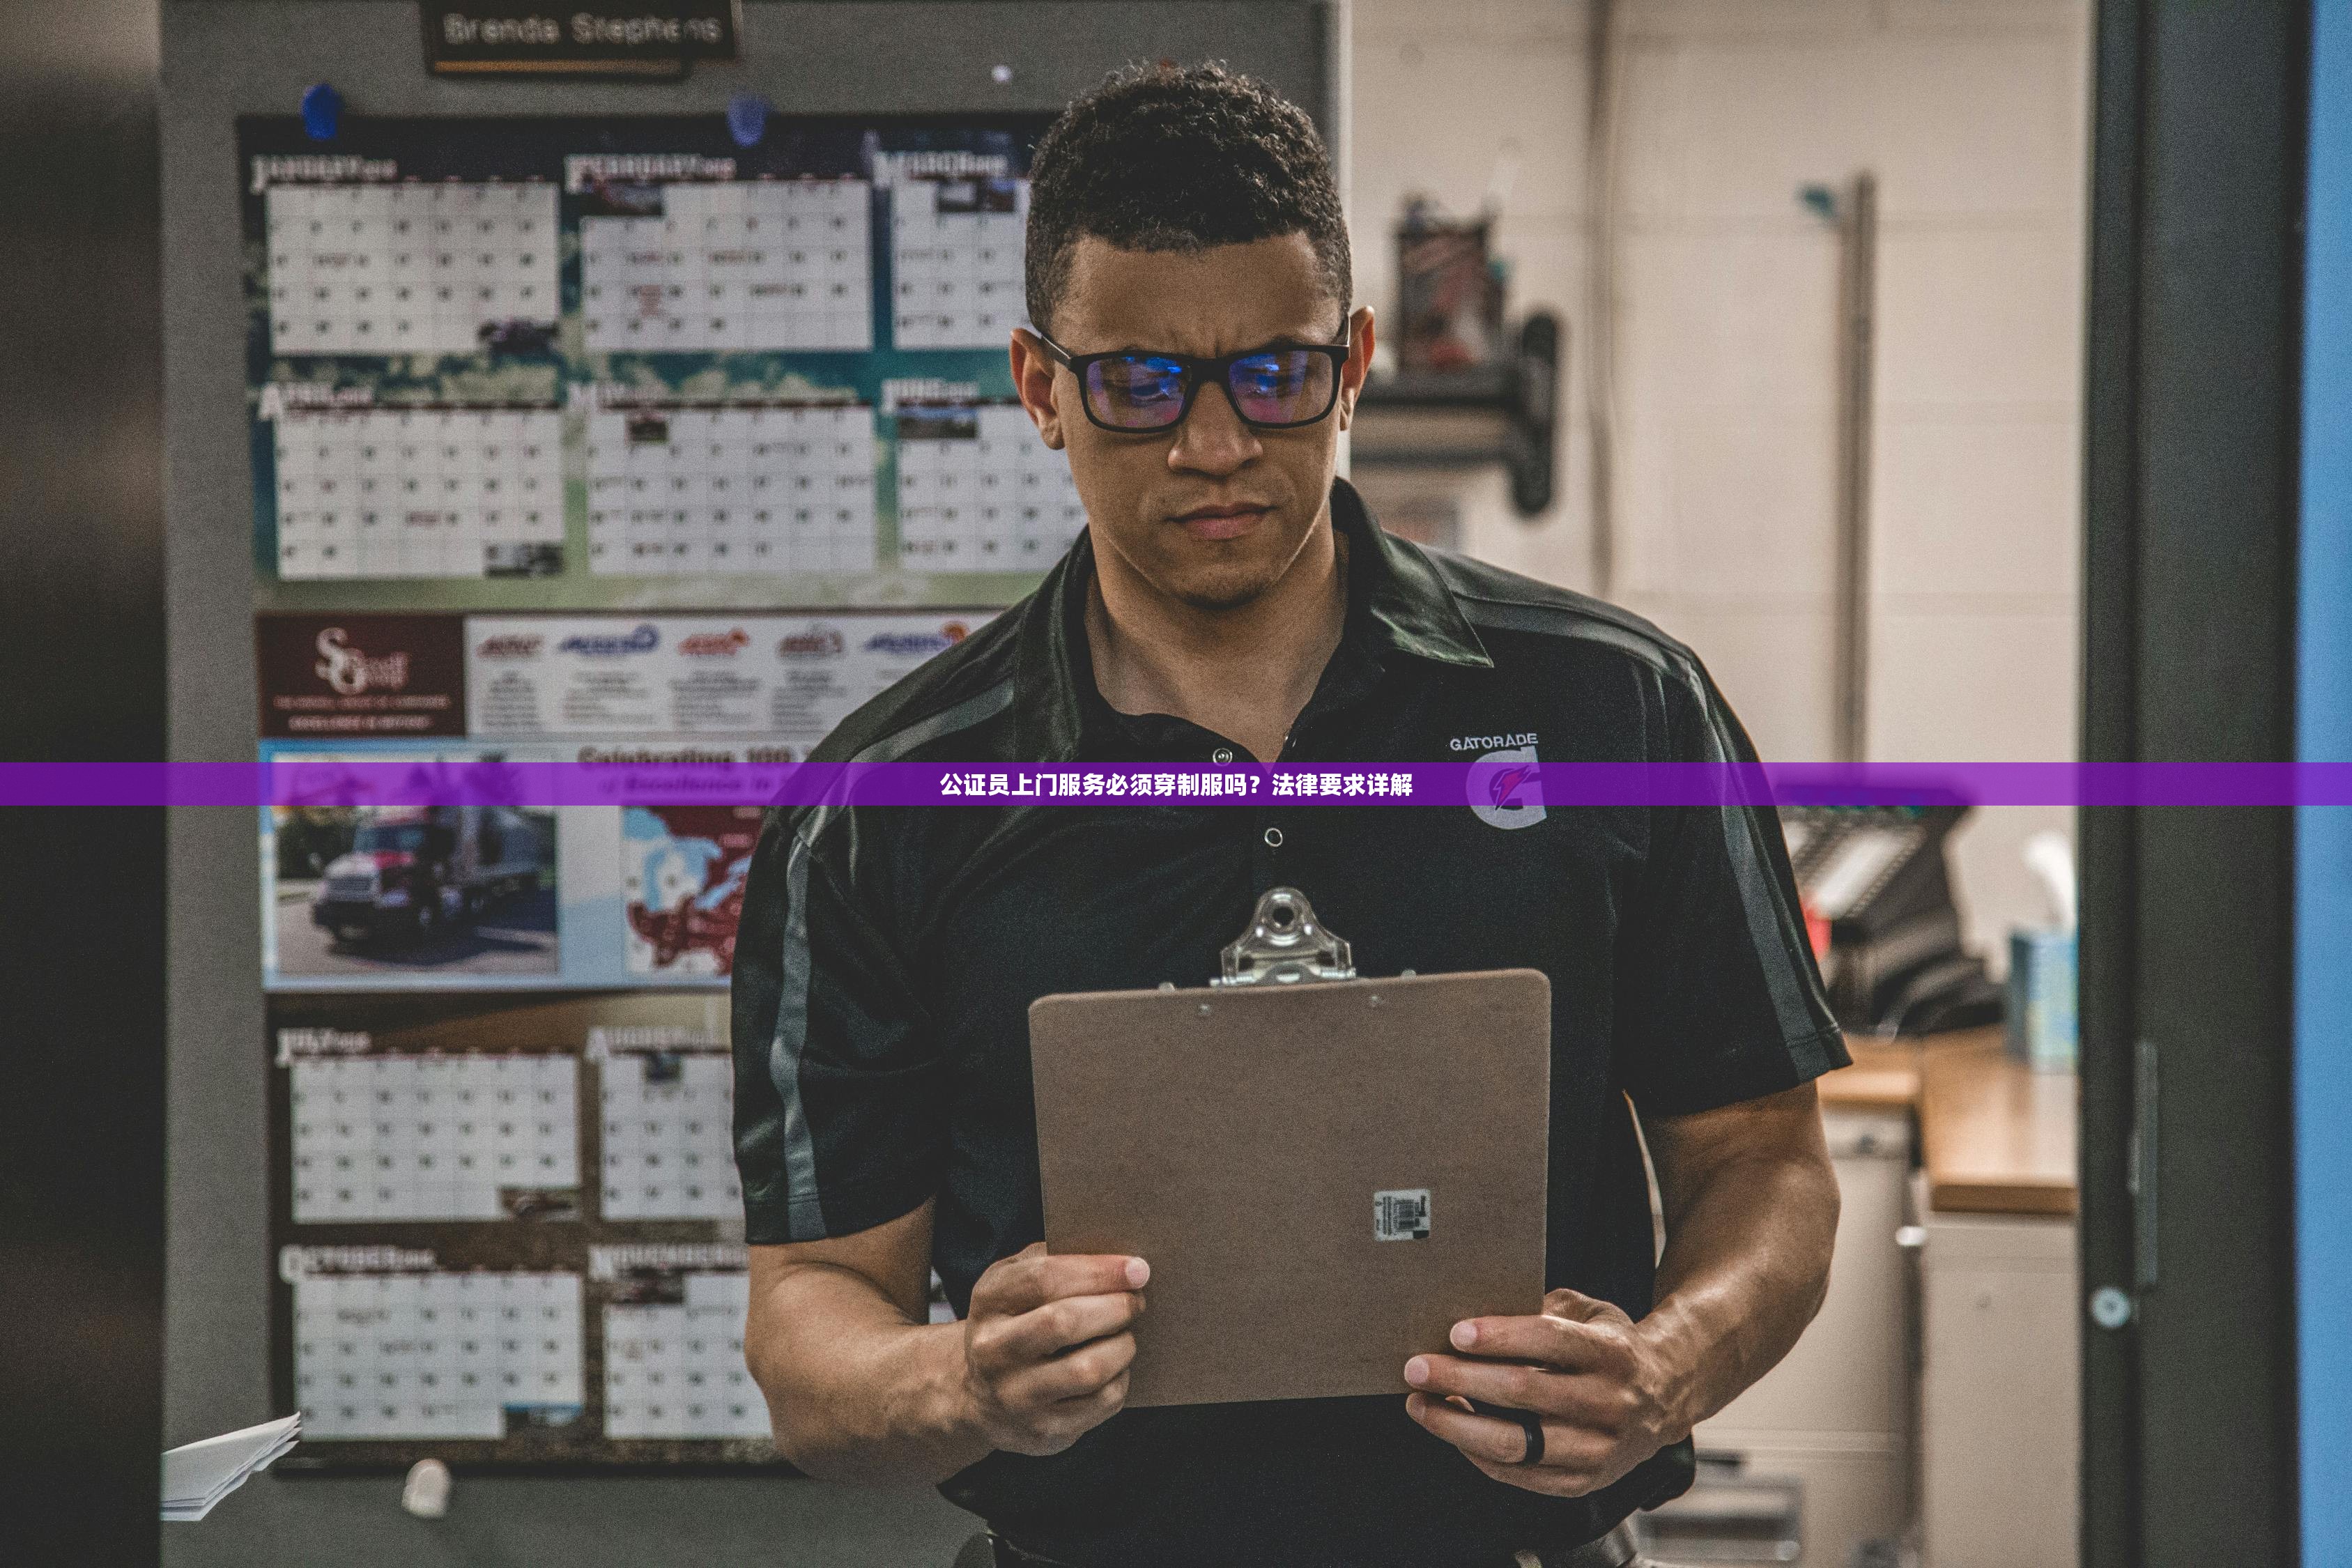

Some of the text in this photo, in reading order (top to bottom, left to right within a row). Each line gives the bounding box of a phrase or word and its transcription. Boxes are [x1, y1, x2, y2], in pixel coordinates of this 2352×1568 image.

[443, 12, 723, 45] Brenda Stephens
[1450, 733, 1538, 751] GATORADE
